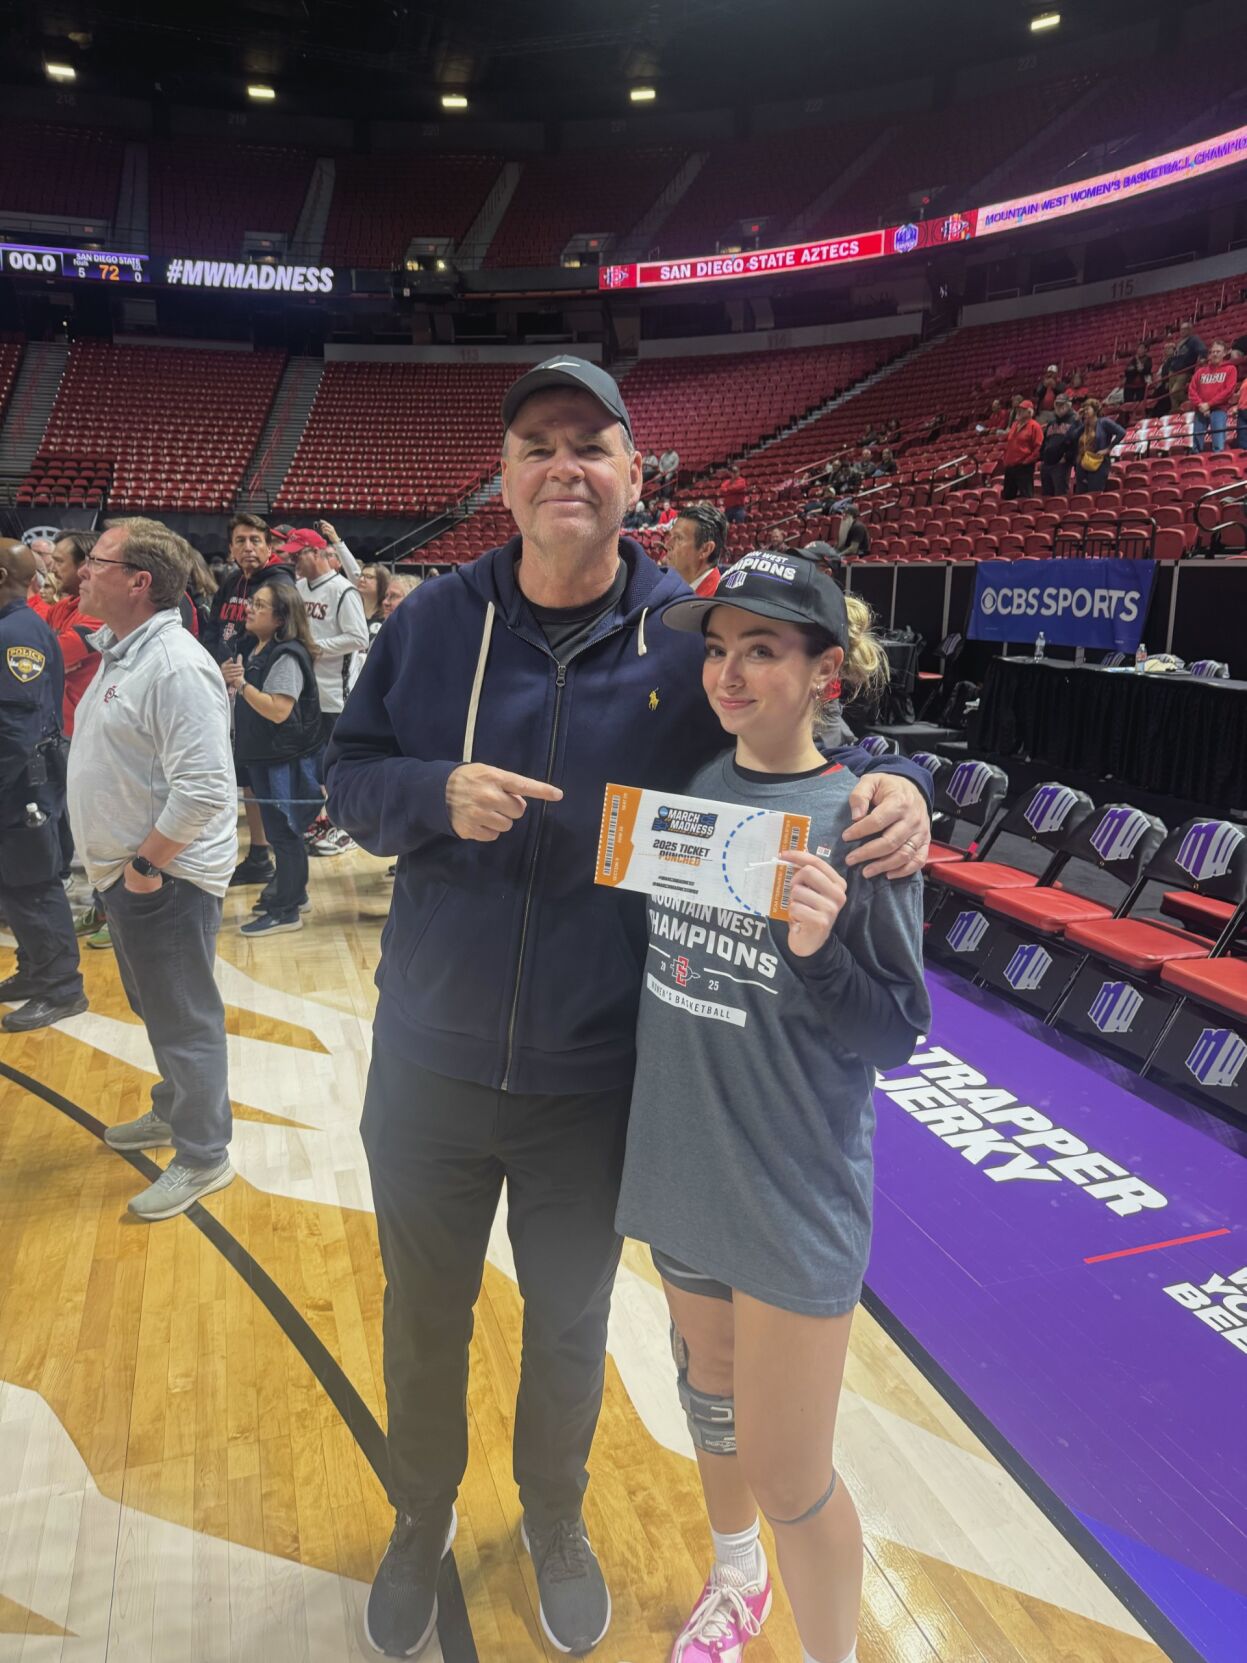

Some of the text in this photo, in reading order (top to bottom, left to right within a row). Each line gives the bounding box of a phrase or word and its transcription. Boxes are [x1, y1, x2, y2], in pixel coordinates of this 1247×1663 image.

[985, 203, 1039, 226] MOUNTAIN
[1041, 195, 1069, 211] WEST
[1071, 180, 1120, 203] WOMEN'S
[1123, 156, 1190, 188] BASKETBALL
[9, 251, 56, 272] 00.0
[76, 253, 92, 262] SAN
[94, 254, 118, 264] DIEGO
[660, 241, 859, 281] SAN DIEGO STATE AZTECS
[99, 264, 119, 280] 72
[134, 271, 142, 283] 0
[167, 258, 334, 292] #MWMADNESS
[1111, 278, 1134, 299] 115
[997, 586, 1140, 622] CBS SPORTS
[667, 809, 701, 823] MARCH
[670, 819, 714, 836] MADNESS
[652, 839, 710, 858] 2025 TICKET
[717, 906, 766, 940] WEST
[649, 909, 778, 979] HAMPIONS
[708, 980, 720, 991] 25
[675, 995, 731, 1019] BASKETBALL
[874, 1067, 1063, 1183] JERKY
[908, 1045, 1168, 1217] TRAPPER
